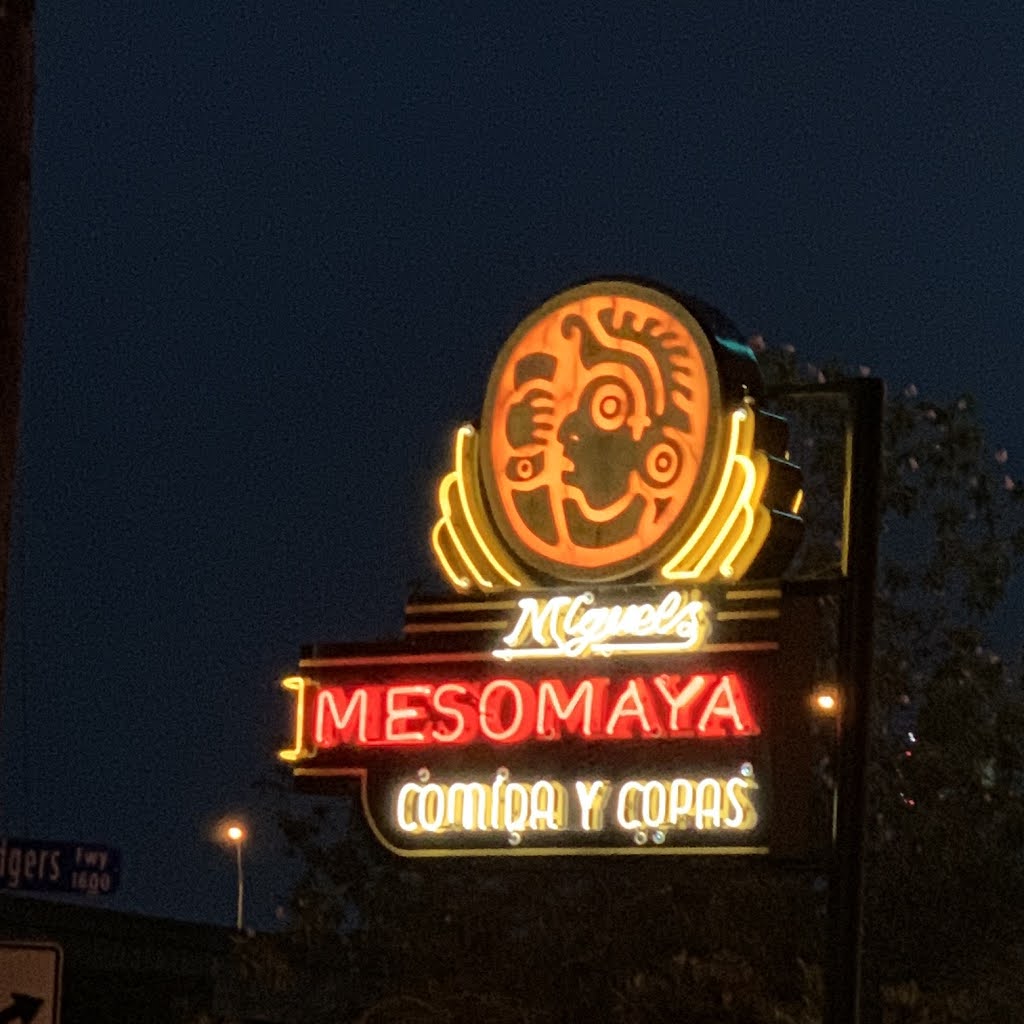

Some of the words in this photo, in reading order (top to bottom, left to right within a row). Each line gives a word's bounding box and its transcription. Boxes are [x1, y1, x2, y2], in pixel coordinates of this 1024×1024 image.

[314, 672, 760, 747] MESOMAYA
[575, 779, 610, 832] Y
[616, 777, 758, 832] COPAS
